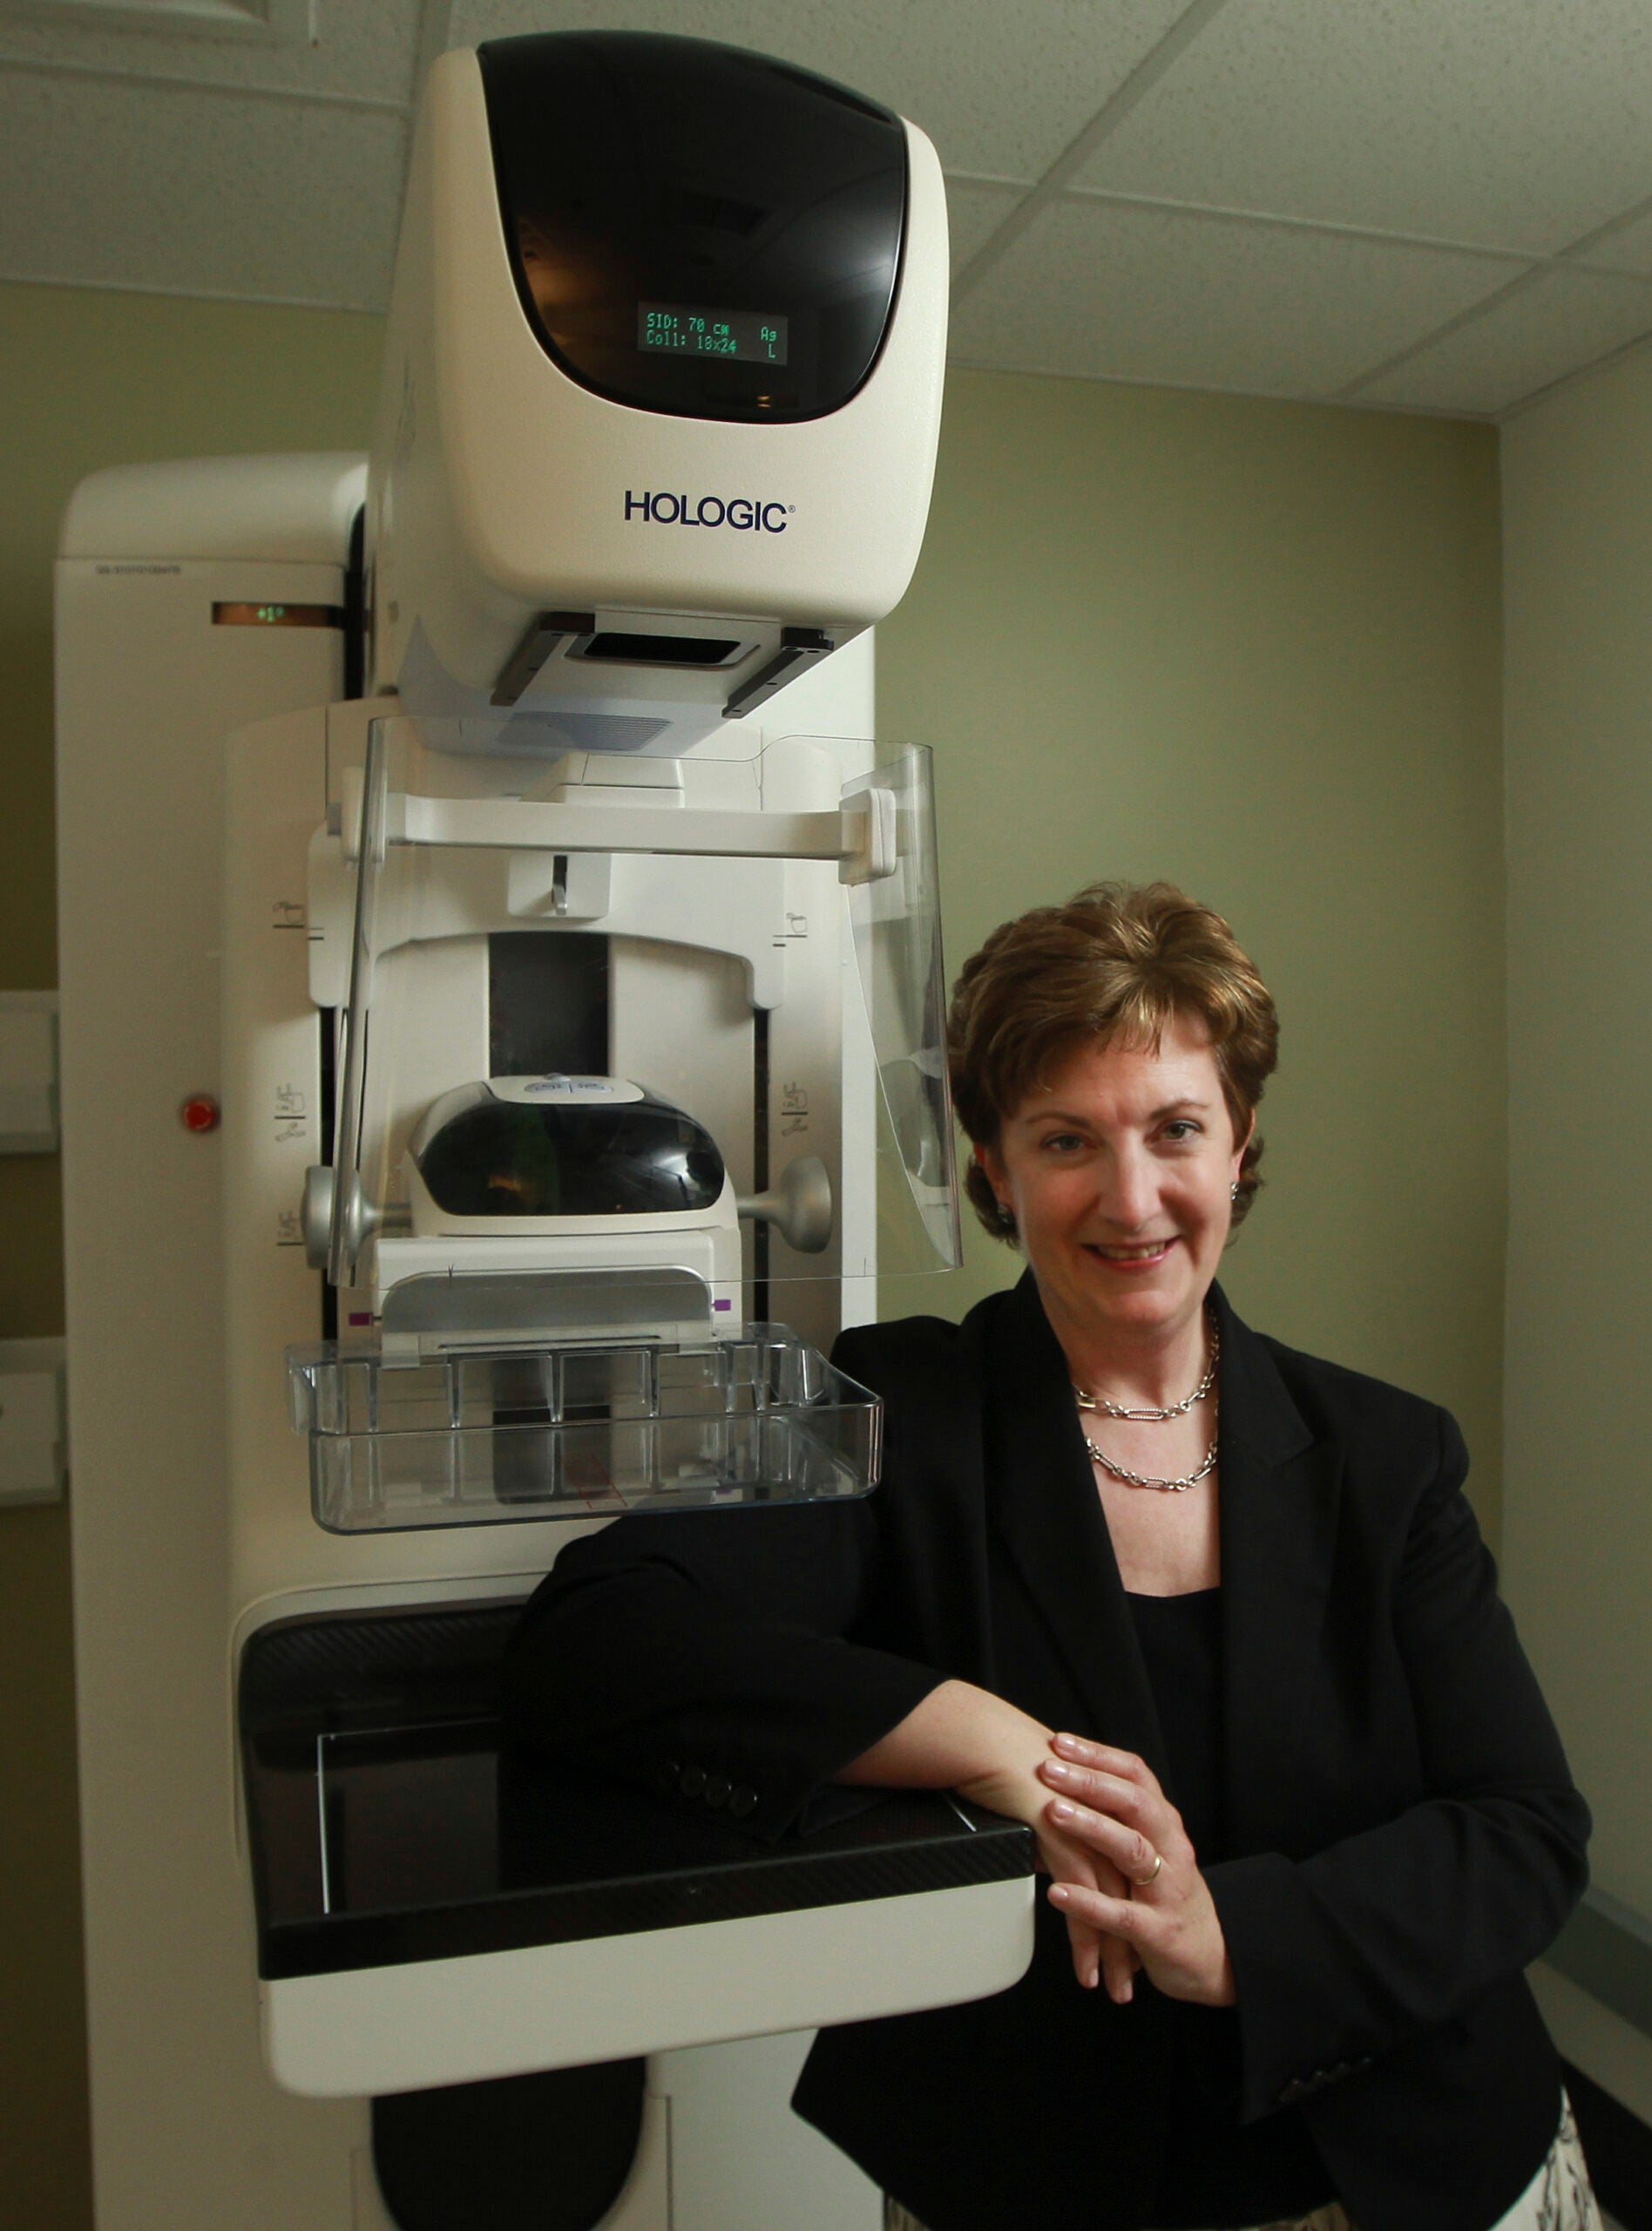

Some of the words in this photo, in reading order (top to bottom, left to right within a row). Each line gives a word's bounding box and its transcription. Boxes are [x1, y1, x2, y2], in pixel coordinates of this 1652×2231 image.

[647, 313, 678, 329] SID:
[688, 317, 705, 332] 70
[713, 323, 729, 336] cm
[647, 329, 686, 347] Coll:
[697, 335, 736, 354] 18x24
[768, 343, 775, 358] L
[625, 490, 787, 533] HOLOGIC
